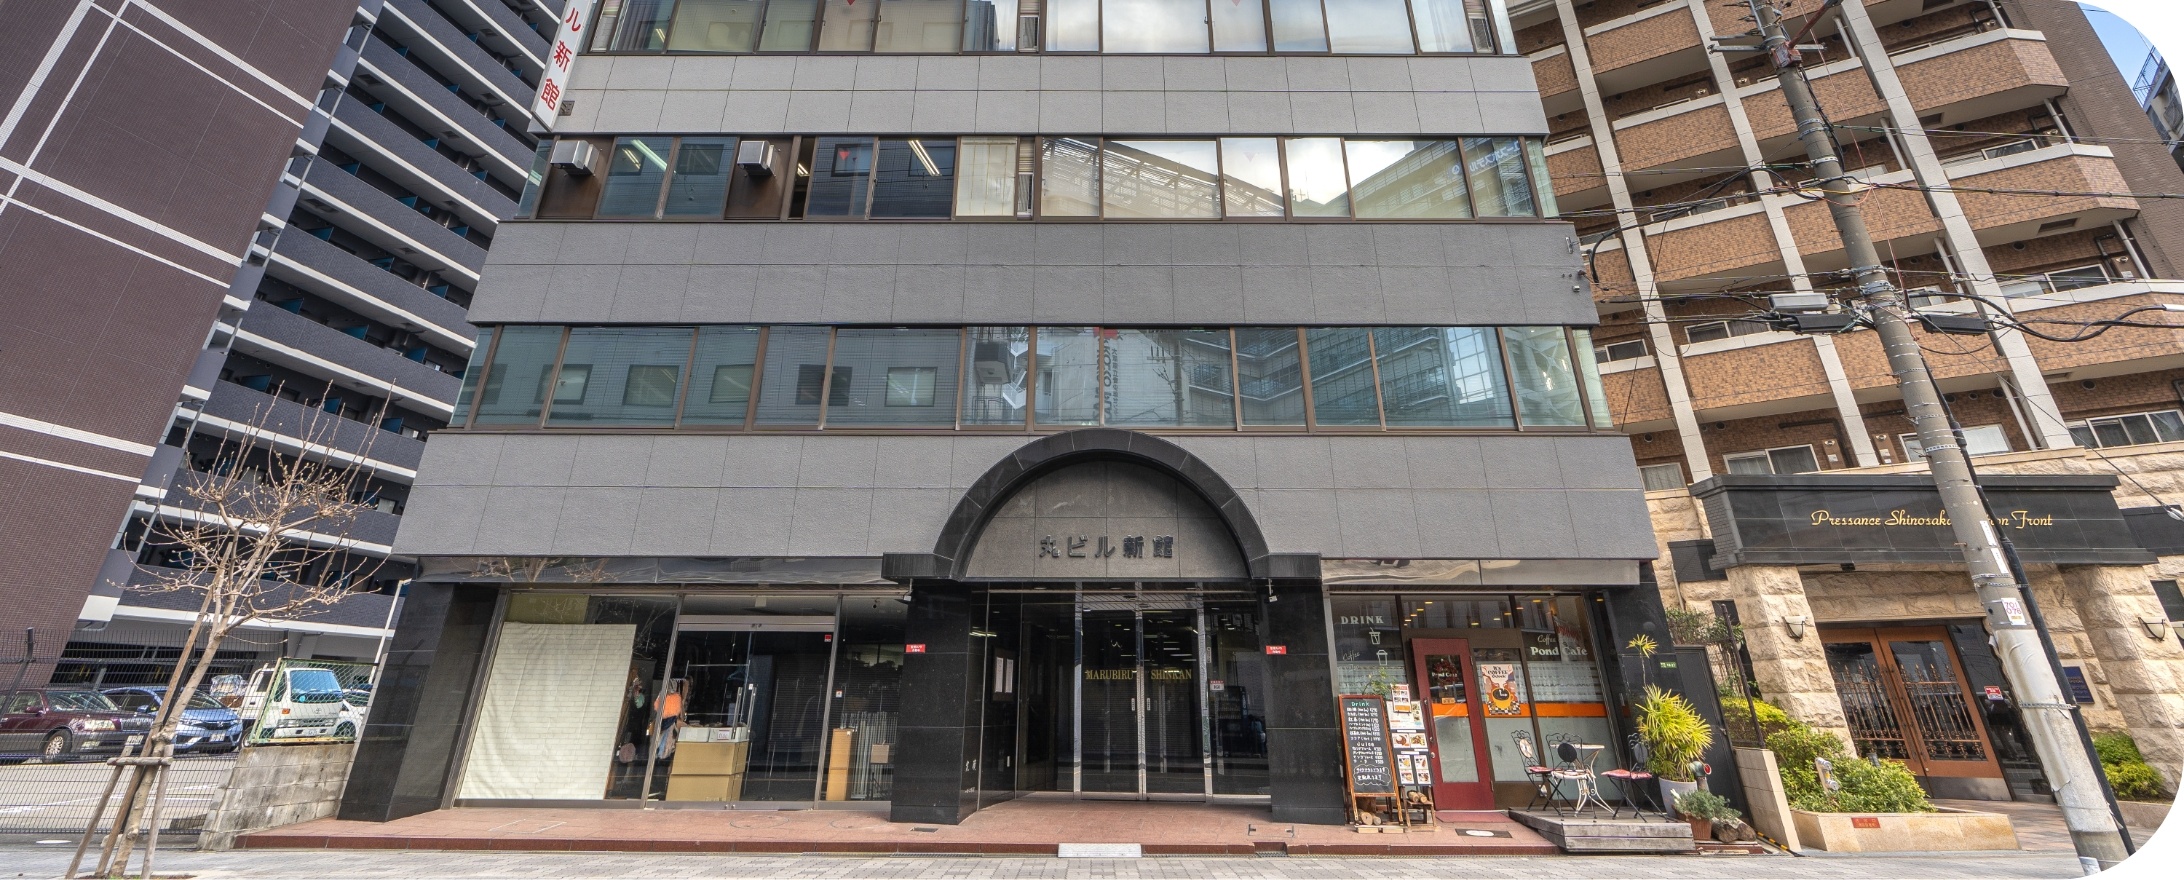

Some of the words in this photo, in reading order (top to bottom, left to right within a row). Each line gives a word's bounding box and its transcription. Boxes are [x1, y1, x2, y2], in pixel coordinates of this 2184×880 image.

[541, 7, 581, 111] ル新館
[1811, 510, 1881, 526] Pressance
[2011, 510, 2053, 529] Front
[1039, 535, 1173, 558] 丸ビル新館
[1340, 615, 1384, 625] DRINK
[1537, 634, 1557, 646] Coffee
[1530, 646, 1560, 656] Pond
[1563, 646, 1588, 656] Cafe
[1085, 669, 1134, 680] MARUBIRU
[1150, 669, 1192, 680] SHINKAN
